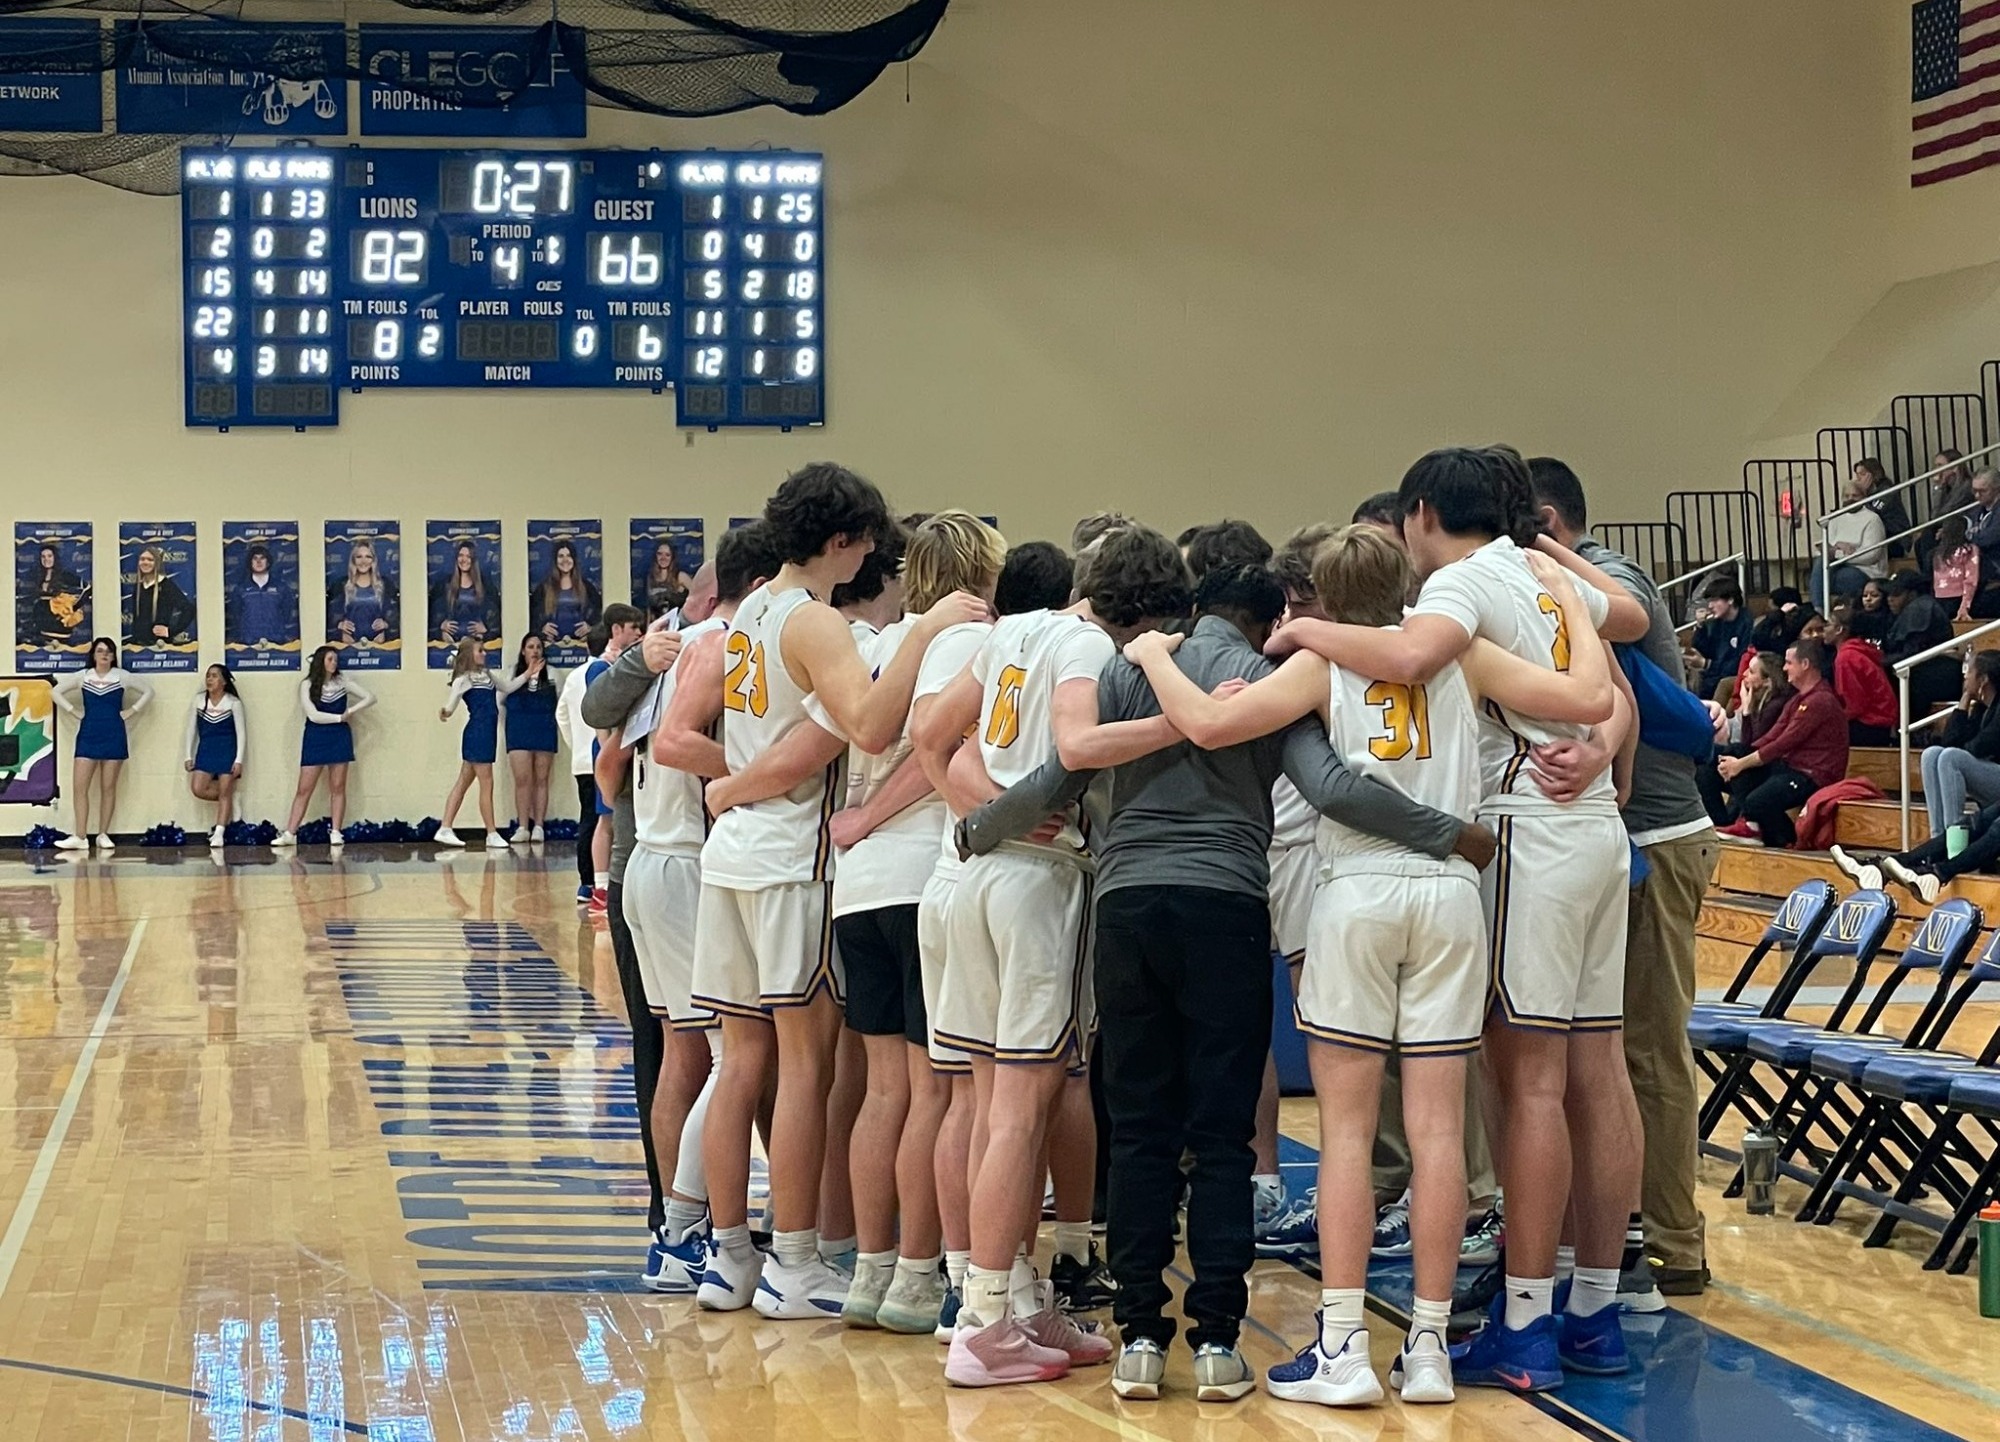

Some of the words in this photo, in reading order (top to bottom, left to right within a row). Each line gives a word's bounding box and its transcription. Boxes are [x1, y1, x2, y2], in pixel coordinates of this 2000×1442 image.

[128, 67, 162, 84] Alumni
[167, 68, 224, 85] Association
[230, 69, 249, 85] Inc.
[473, 162, 570, 213] 0:27
[220, 190, 230, 216] 1
[263, 191, 273, 216] 1
[290, 190, 325, 219] 33
[360, 198, 418, 219] LIONS
[594, 200, 654, 220] GUEST
[712, 195, 722, 219] 1
[753, 195, 763, 220] 1
[777, 193, 813, 223] 25
[211, 228, 231, 258] 2
[254, 228, 273, 258] 0
[306, 228, 326, 258] 2
[471, 238, 478, 248] P
[483, 224, 532, 239] PERIOD
[536, 239, 544, 249] P
[703, 231, 722, 260] 0
[745, 234, 763, 259] 4
[794, 231, 814, 261] 0
[362, 231, 424, 282] 82
[472, 251, 484, 262] TO
[495, 246, 519, 281] 4
[532, 251, 544, 262] TO
[599, 236, 658, 284] 66
[204, 267, 231, 297] 15
[255, 270, 274, 294] 4
[299, 270, 327, 295] 14
[704, 270, 722, 299] 5
[744, 270, 763, 299] 2
[787, 270, 814, 300] 18
[194, 306, 233, 336] 22
[264, 309, 275, 334] 1
[299, 309, 327, 334] 11
[343, 300, 362, 314] TM
[368, 300, 407, 314] FOULS
[420, 308, 439, 320] TOL
[460, 301, 509, 316] PLAYER
[524, 301, 564, 316] FOULS
[576, 309, 594, 320] TOL
[608, 302, 627, 316] TM
[632, 302, 671, 316] FOULS
[696, 310, 723, 335] 11
[753, 311, 764, 336] 1
[796, 309, 814, 338] 5
[374, 321, 399, 359] 8
[419, 325, 440, 355] 2
[575, 326, 595, 355] 0
[638, 324, 661, 360] 6
[213, 348, 233, 373] 4
[257, 346, 276, 376] 3
[300, 348, 328, 374] 14
[351, 366, 400, 380] POINTS
[485, 366, 531, 380] MATCH
[616, 366, 663, 381] POINTS
[696, 347, 723, 377] 12
[754, 349, 764, 374] 1
[795, 347, 815, 377] 8
[1364, 680, 1432, 762] 31
